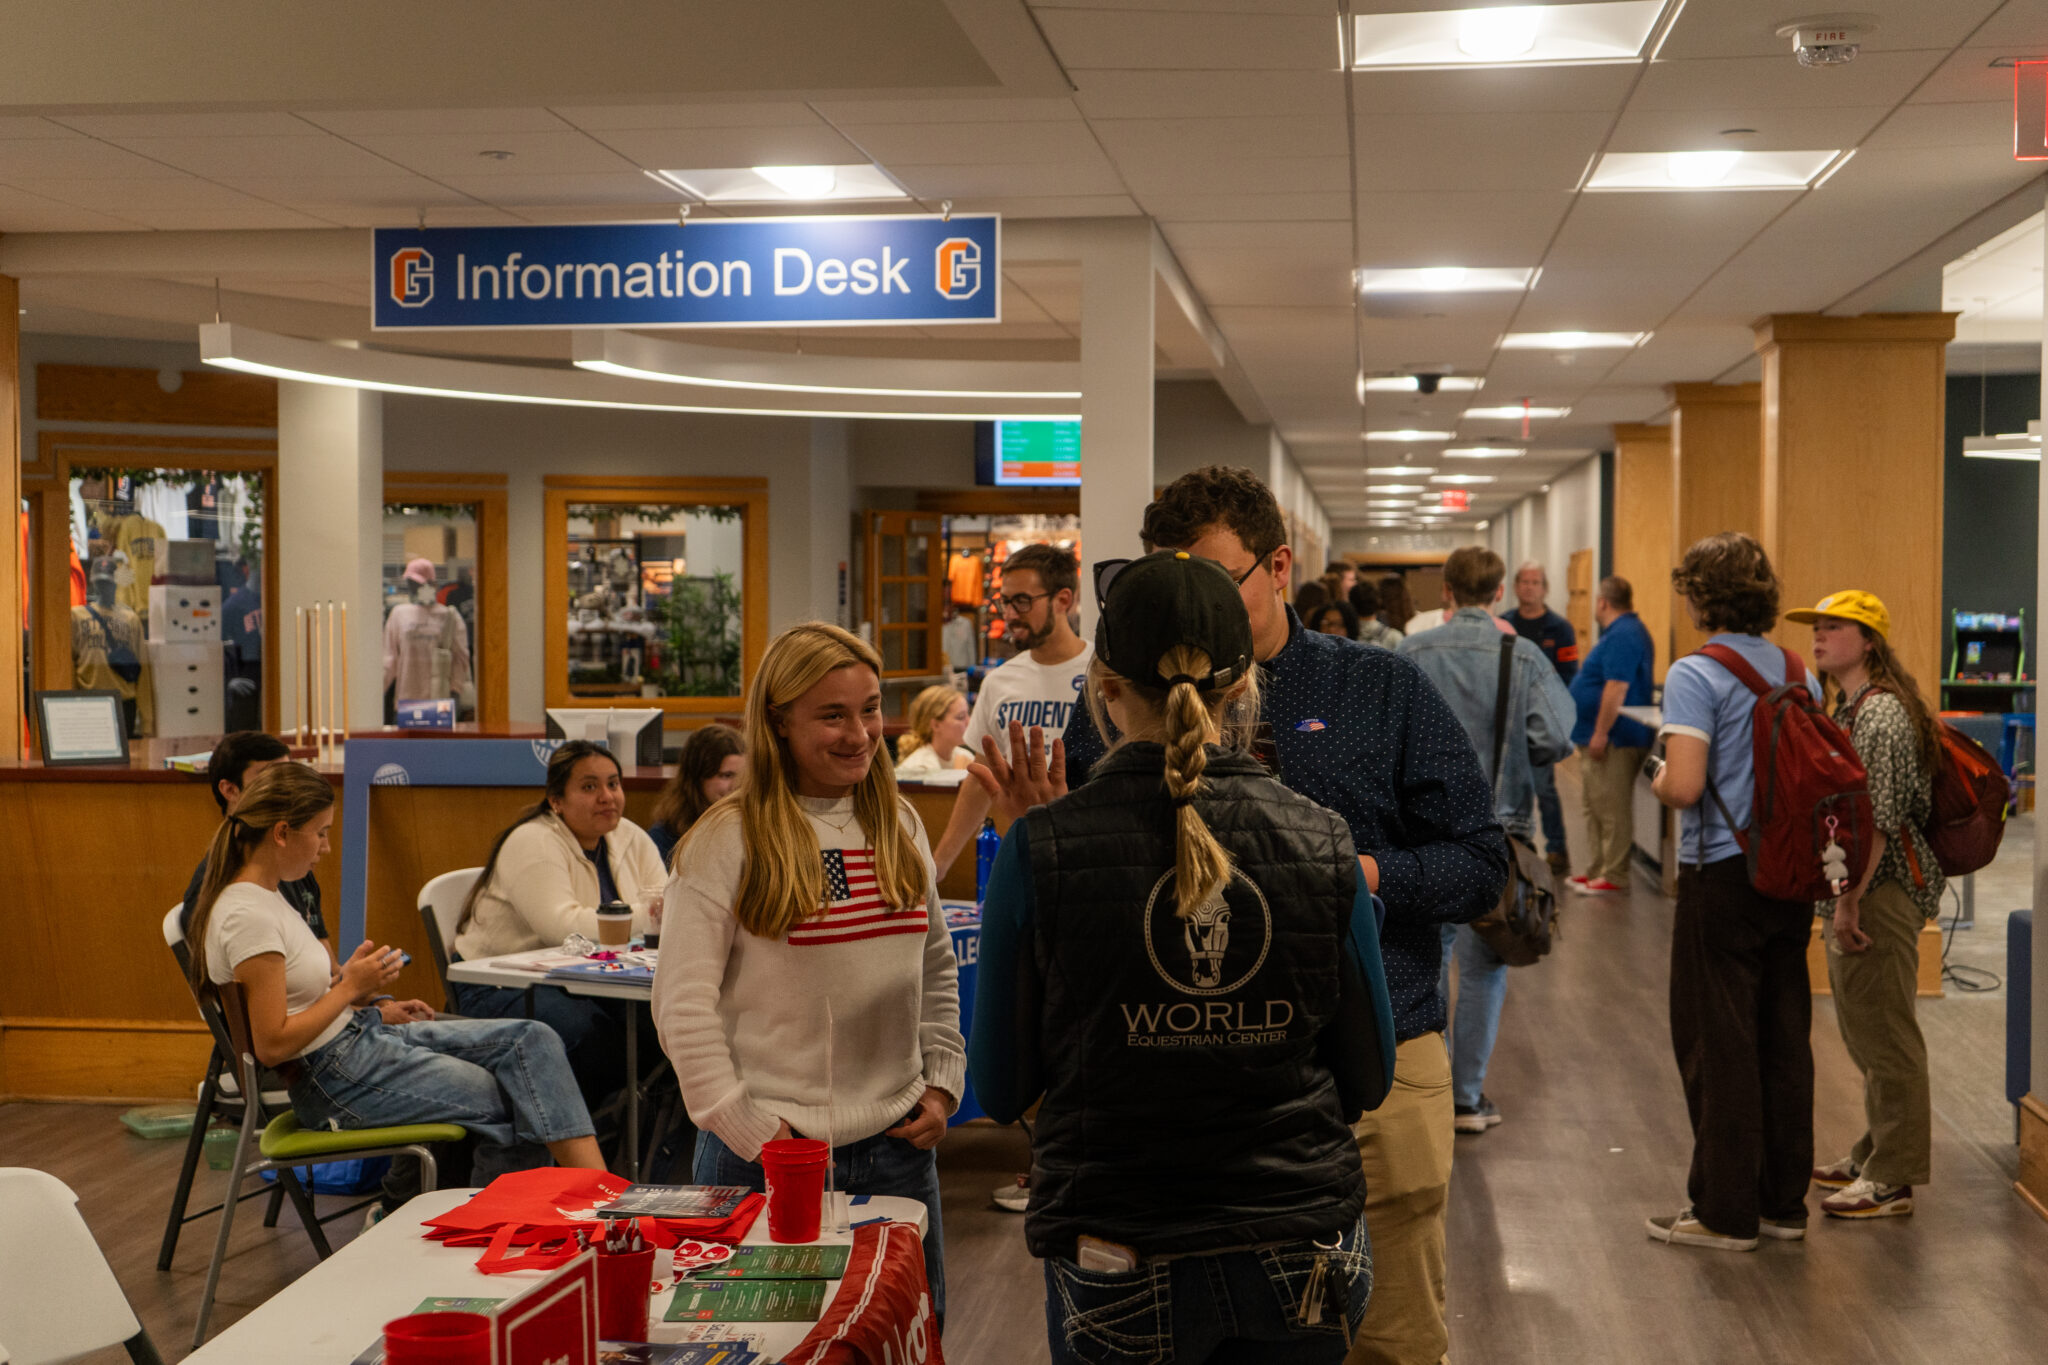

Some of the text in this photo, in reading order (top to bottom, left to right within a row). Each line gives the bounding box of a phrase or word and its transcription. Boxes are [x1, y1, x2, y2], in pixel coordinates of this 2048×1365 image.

[1815, 31, 1847, 41] FIRE
[390, 237, 981, 308] G Information Desk G
[1120, 1000, 1294, 1033] WORLD
[1127, 1031, 1287, 1047] EQUESTRIAN CENTER
